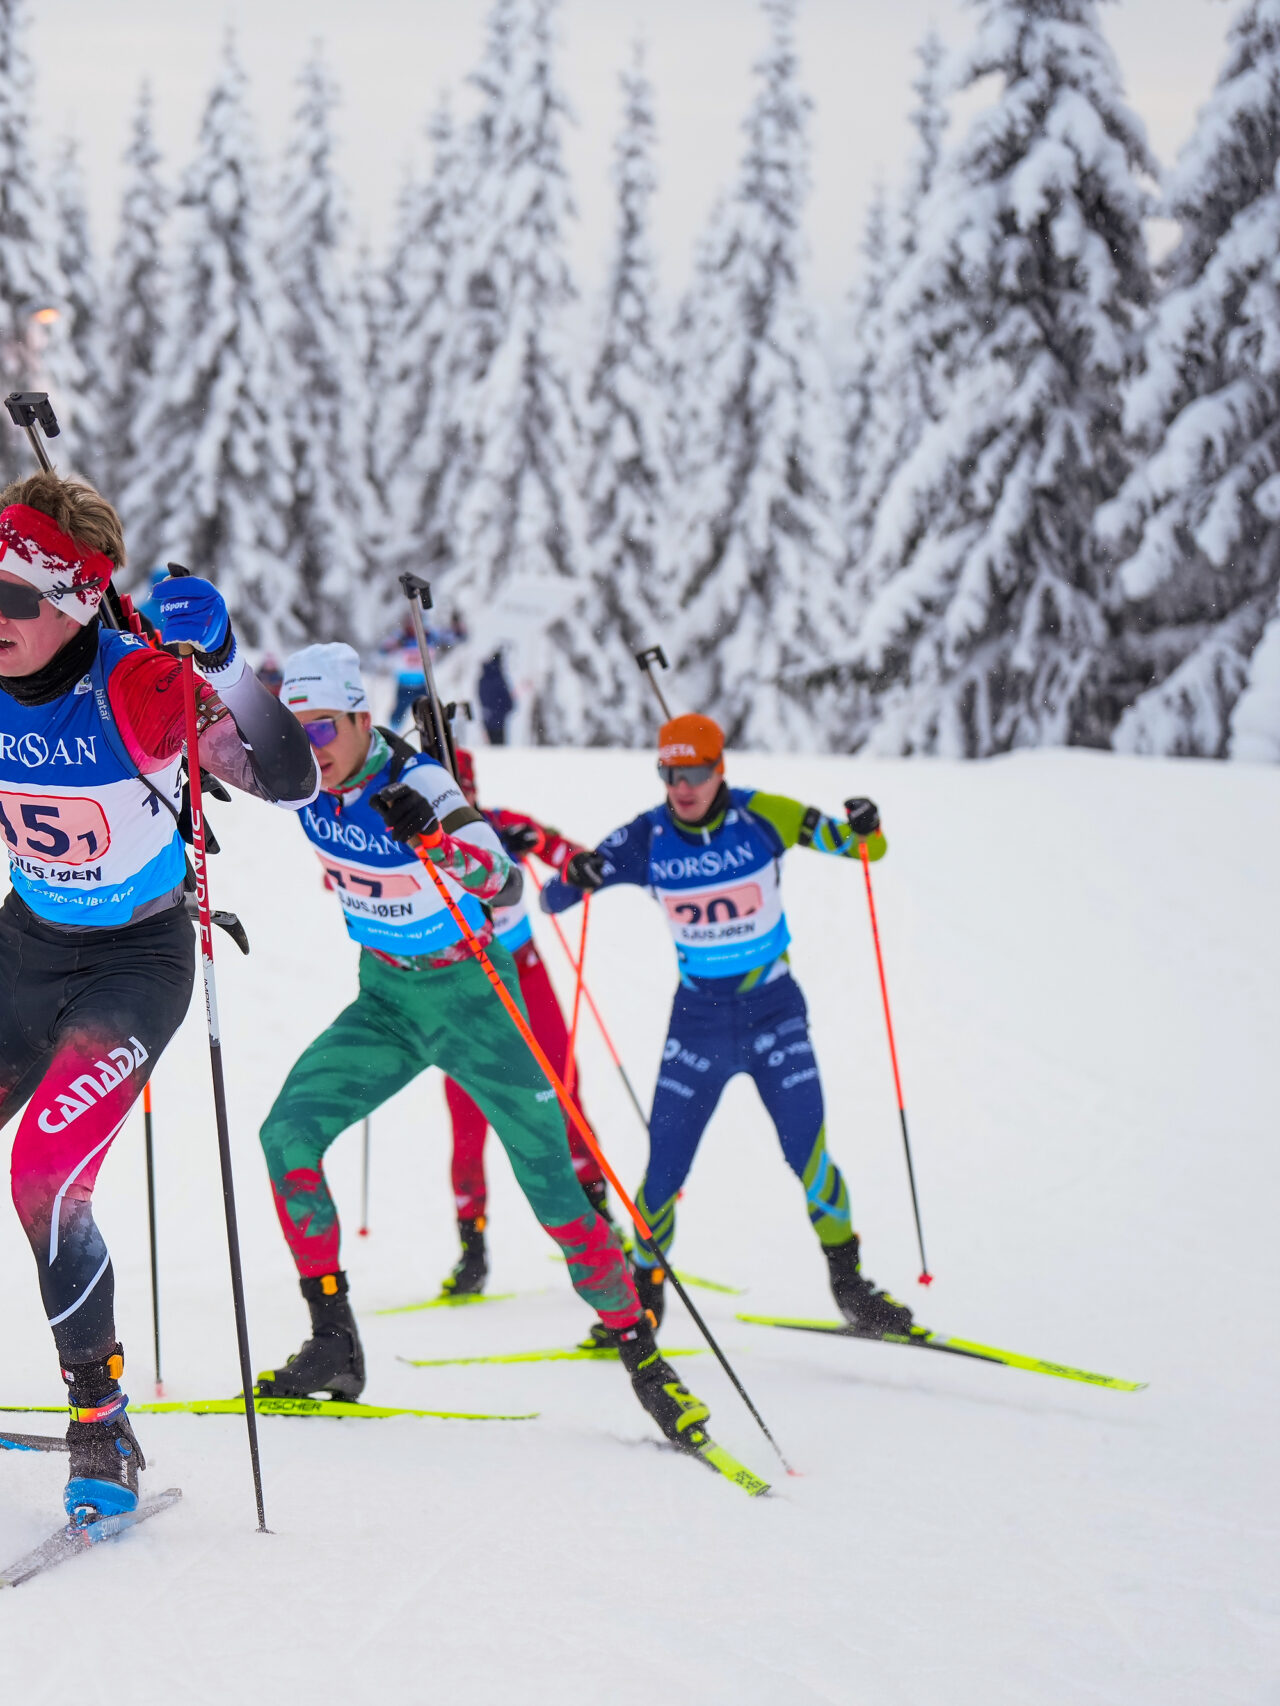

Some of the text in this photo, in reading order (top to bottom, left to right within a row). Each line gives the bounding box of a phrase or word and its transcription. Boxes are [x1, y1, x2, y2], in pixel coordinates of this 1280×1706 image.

[305, 805, 404, 855] NORSAN
[650, 841, 755, 881] NORSAN
[37, 1036, 150, 1134] CANADA
[97, 1403, 122, 1418] SALOMON
